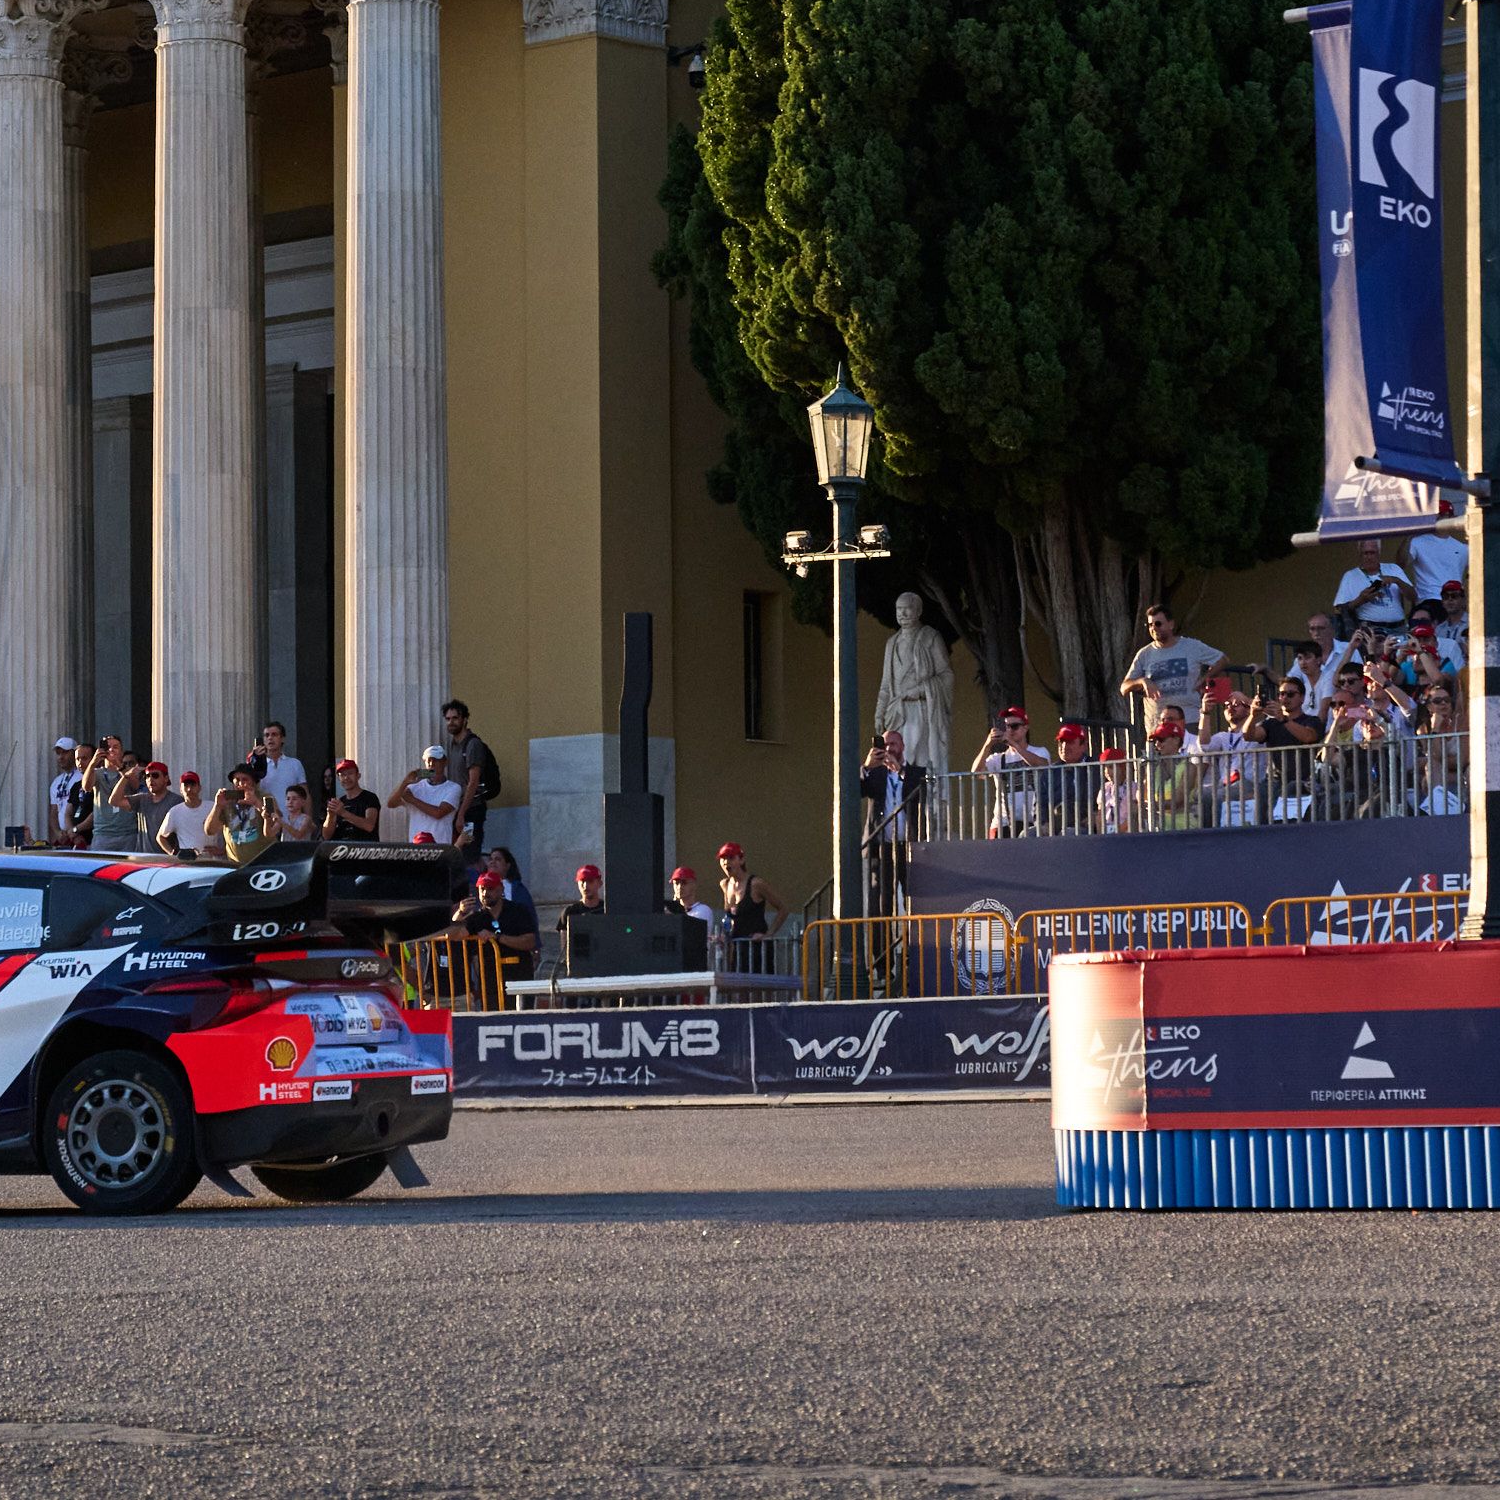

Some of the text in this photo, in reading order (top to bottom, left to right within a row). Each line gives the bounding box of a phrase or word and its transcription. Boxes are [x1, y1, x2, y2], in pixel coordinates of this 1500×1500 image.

[1380, 195, 1431, 228] EKO
[1036, 908, 1248, 937] HELLENIC REPUBLIC
[233, 921, 279, 941] i20
[150, 952, 206, 961] HYUNDAI
[149, 960, 189, 969] STEEL
[1160, 1025, 1200, 1040] EKO
[478, 1019, 720, 1062] FORUM8
[795, 1065, 857, 1079] LUBRICANTS
[955, 1061, 1018, 1075] LUBRICANTS
[278, 1081, 310, 1091] HYUNDAI
[278, 1091, 303, 1099] STEEL
